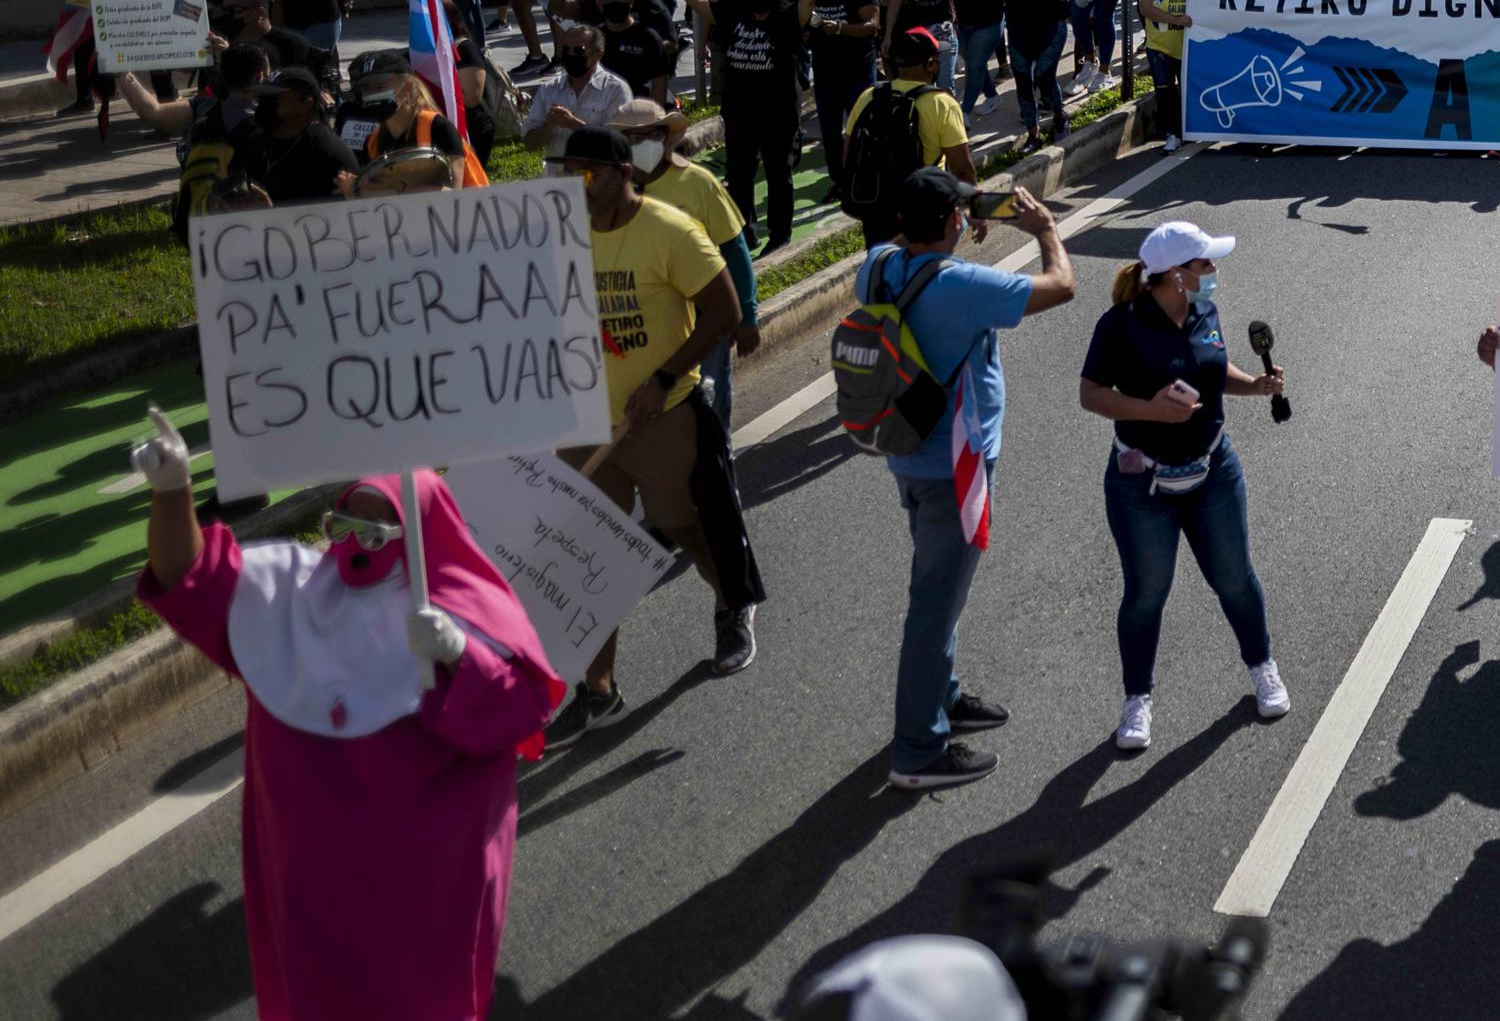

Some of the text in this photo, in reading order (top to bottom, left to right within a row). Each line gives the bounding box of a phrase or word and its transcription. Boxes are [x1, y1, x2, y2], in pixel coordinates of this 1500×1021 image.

[198, 189, 592, 283] ¡GOBERNADOR
[595, 270, 636, 292] USTICIA
[322, 260, 597, 344] FUERAAA
[598, 295, 639, 315] ALARIAL
[602, 314, 645, 333] ETIRO
[836, 341, 880, 366] PUMA
[225, 335, 603, 437] ES QUE VAAS!
[507, 455, 546, 487] Retir
[592, 507, 625, 539] unidos
[533, 516, 608, 595] Respeta
[624, 536, 654, 563] todos
[495, 544, 599, 649] El magisterio
